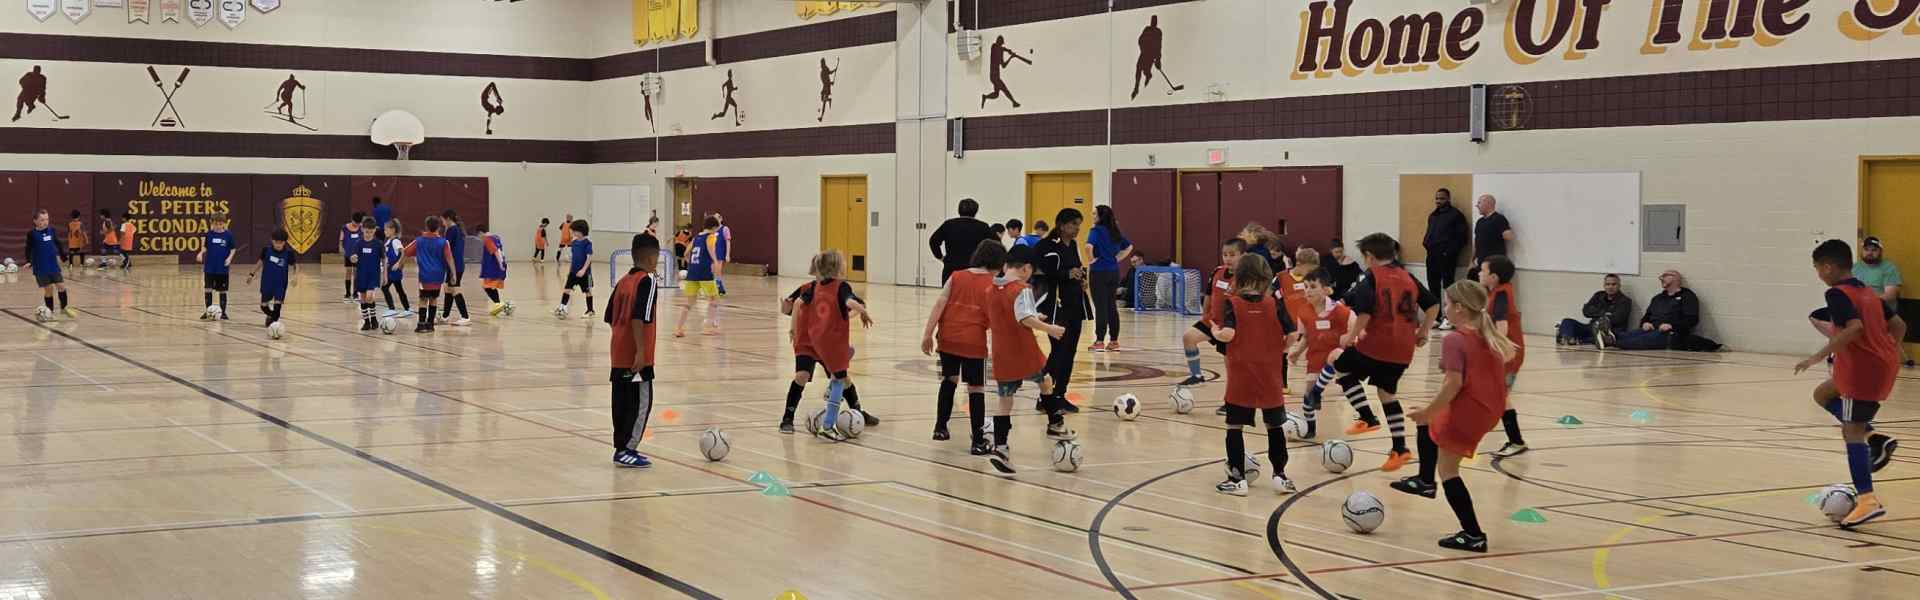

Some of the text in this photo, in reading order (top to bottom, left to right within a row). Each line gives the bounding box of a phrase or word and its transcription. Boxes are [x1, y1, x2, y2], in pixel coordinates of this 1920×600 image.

[1293, 1, 1484, 77] Home
[139, 180, 213, 197] Welcome to
[128, 200, 230, 215] ST. PETER'S
[128, 219, 231, 234] ECONDA
